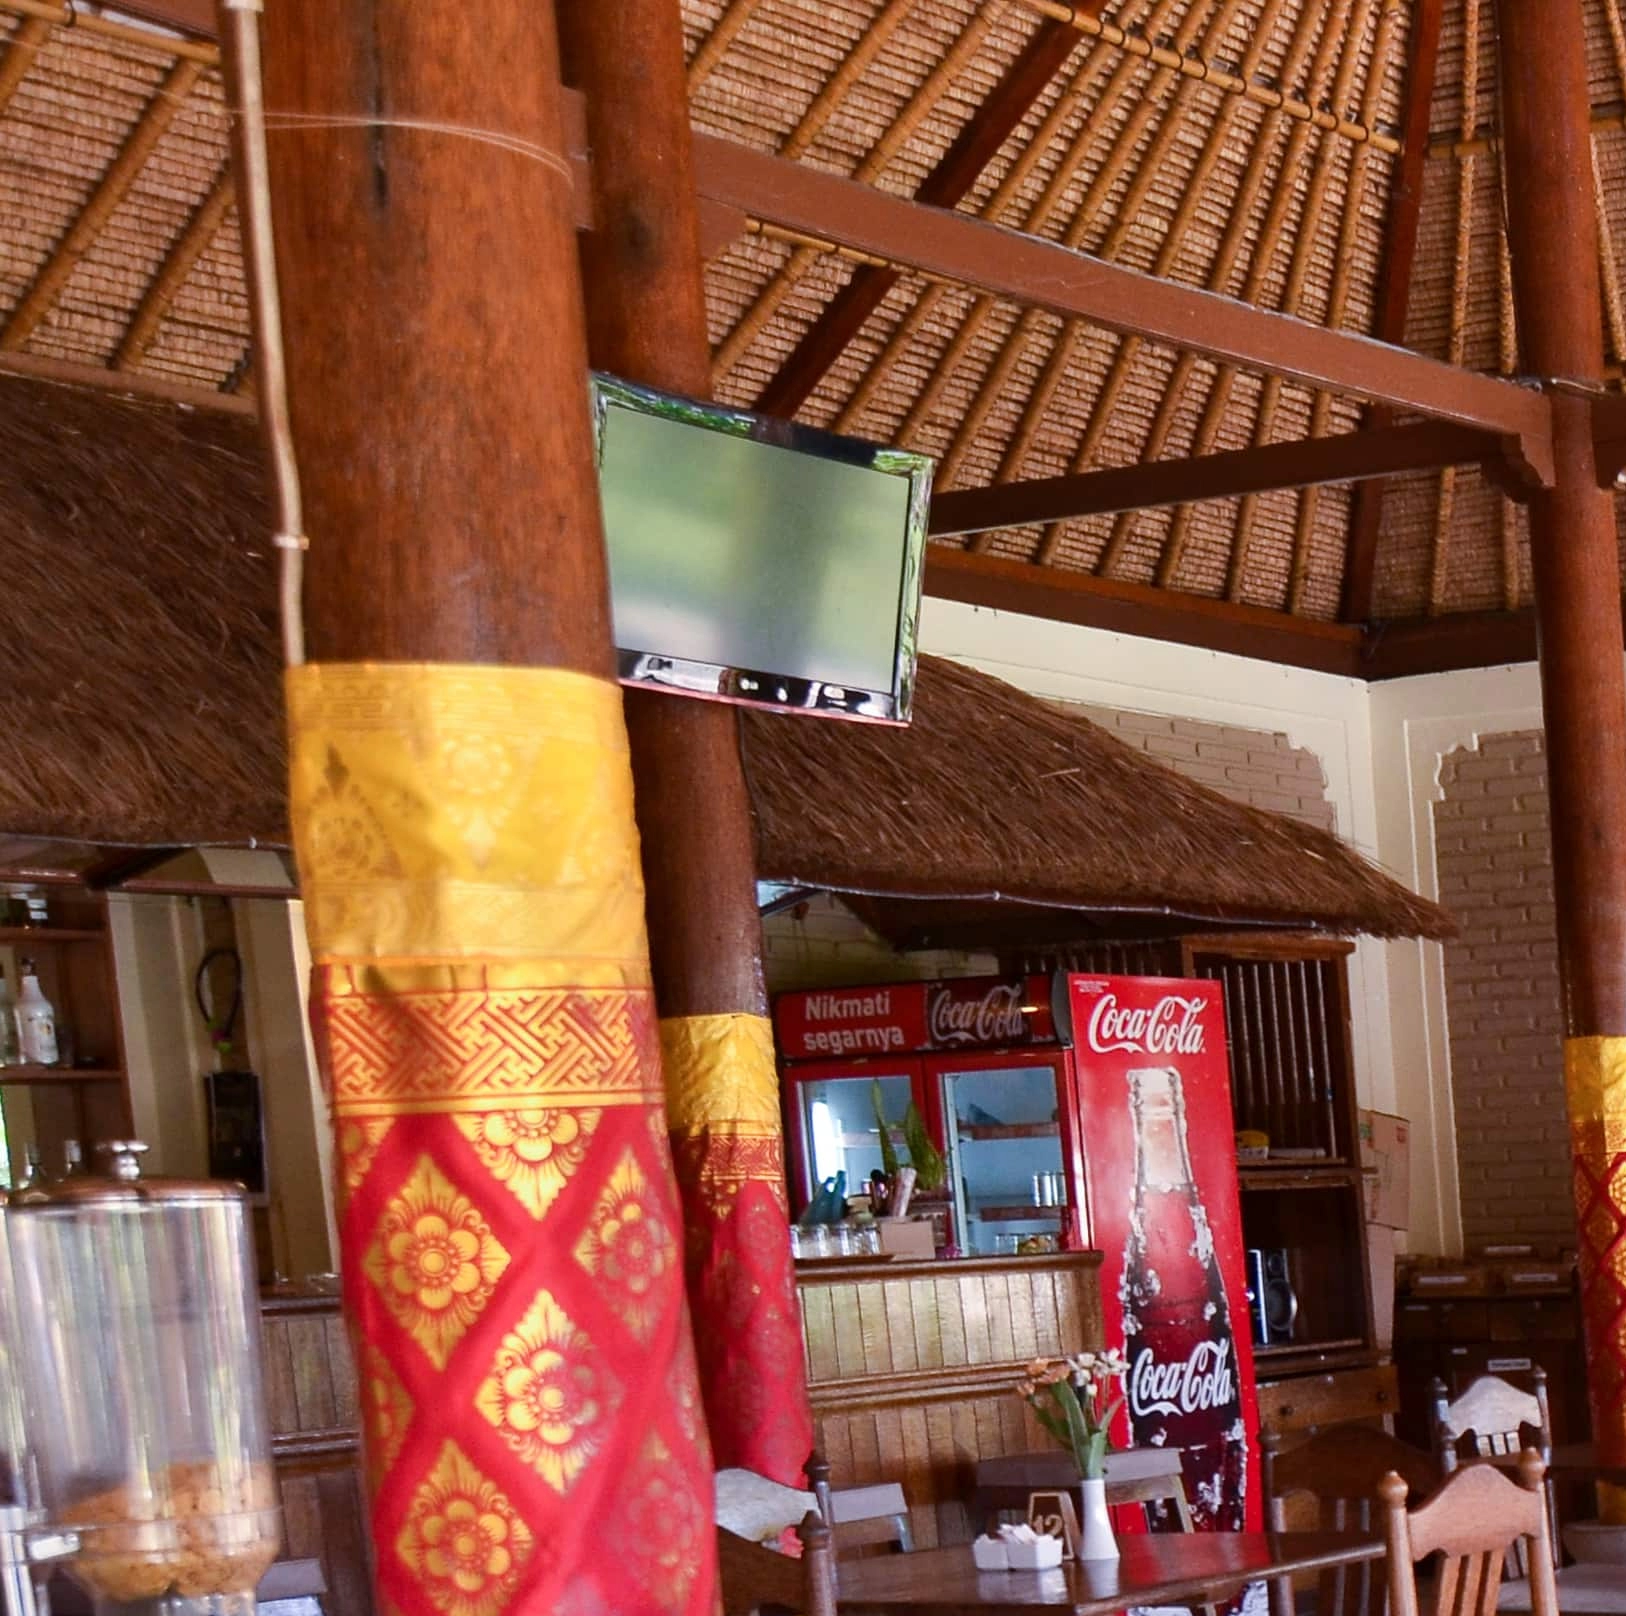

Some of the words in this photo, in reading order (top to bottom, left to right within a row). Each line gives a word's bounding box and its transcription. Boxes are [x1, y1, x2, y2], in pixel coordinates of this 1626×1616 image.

[805, 991, 891, 1021] Nikmati
[931, 983, 1025, 1041] Coca-Cola
[1088, 994, 1208, 1054] Coca-Cola
[803, 1026, 905, 1055] segarnya
[1132, 1338, 1236, 1416] Coca-Cola
